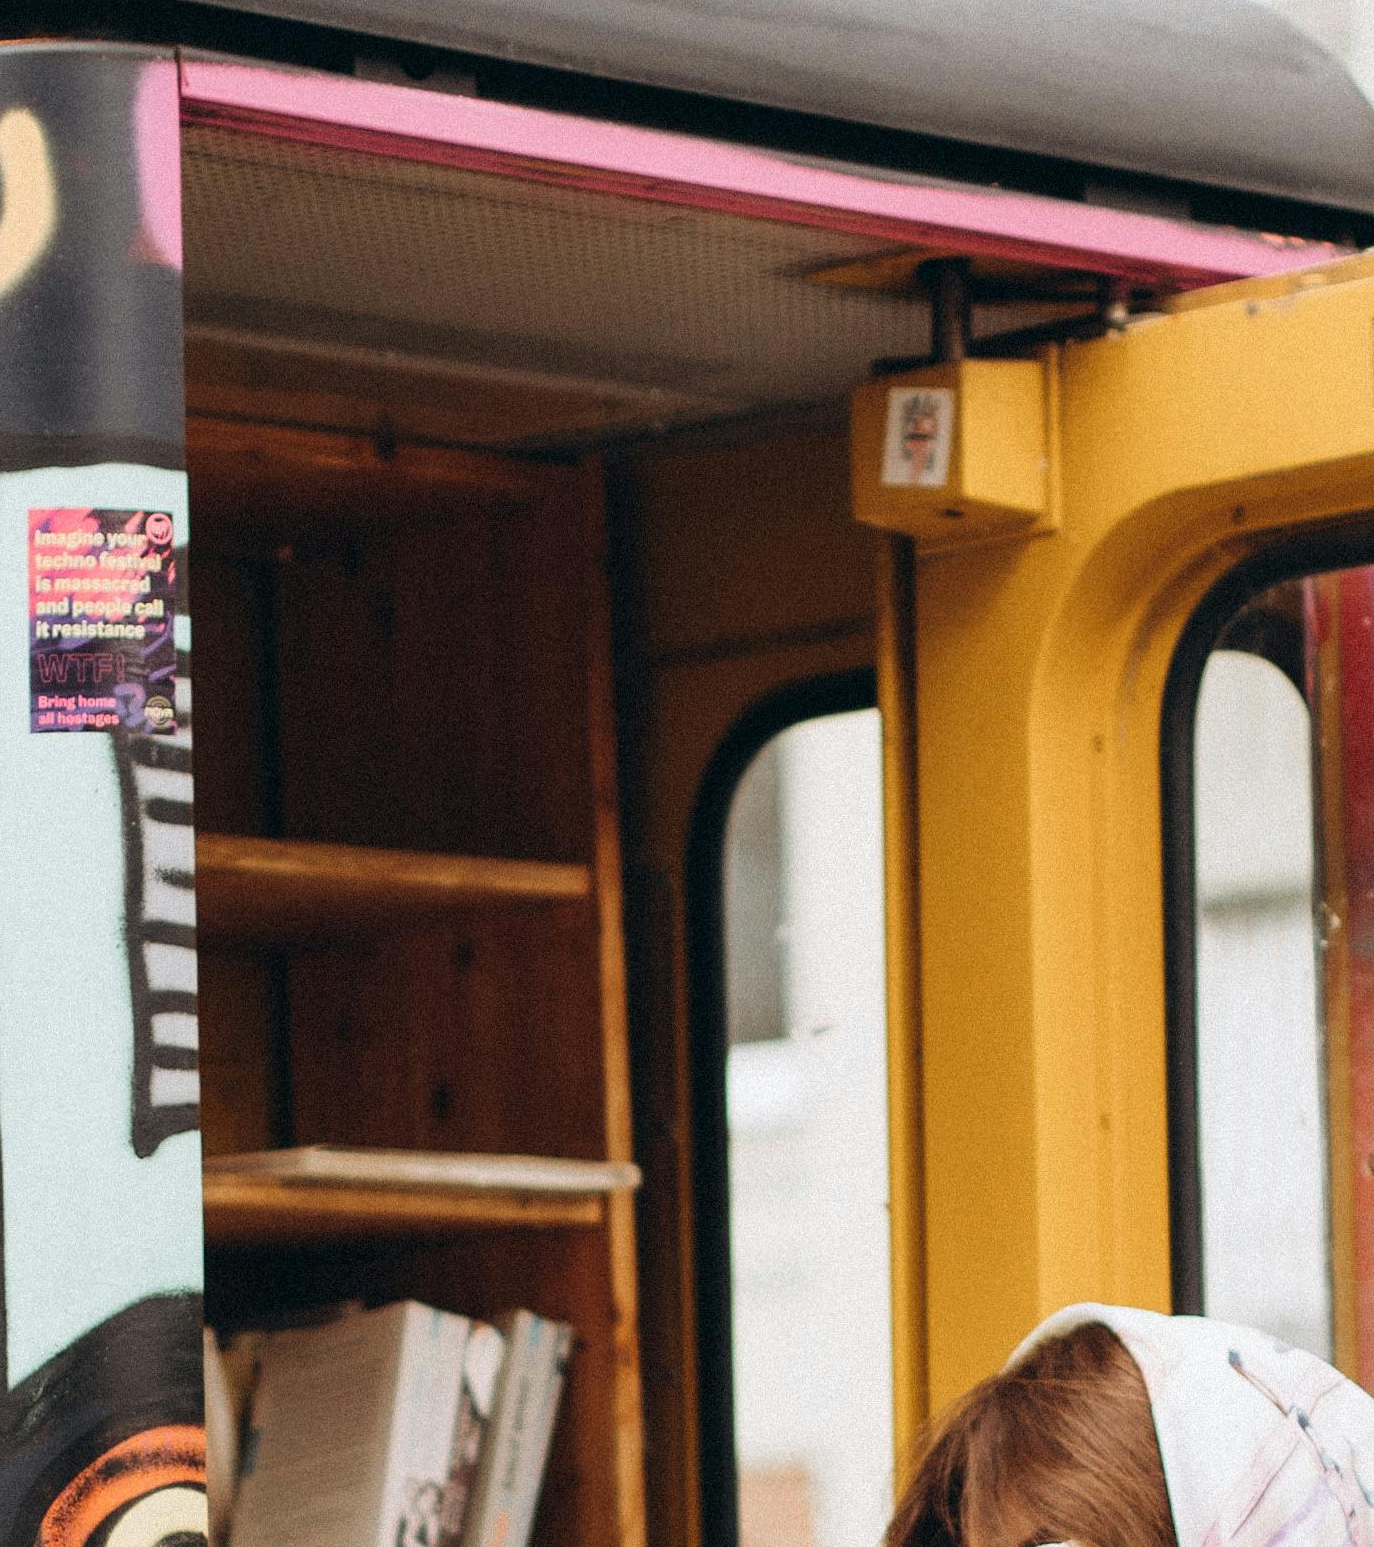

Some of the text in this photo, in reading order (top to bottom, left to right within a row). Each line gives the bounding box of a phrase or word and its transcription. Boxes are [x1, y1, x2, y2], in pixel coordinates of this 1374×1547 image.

[35, 530, 147, 551] Imagine your
[35, 552, 163, 573] techno festival
[36, 575, 152, 594] is massacred
[36, 598, 165, 618] and people call
[36, 621, 146, 640] it resistance
[38, 654, 125, 682] WTF!
[38, 695, 117, 711] Bring home
[38, 713, 120, 728] all hostages
